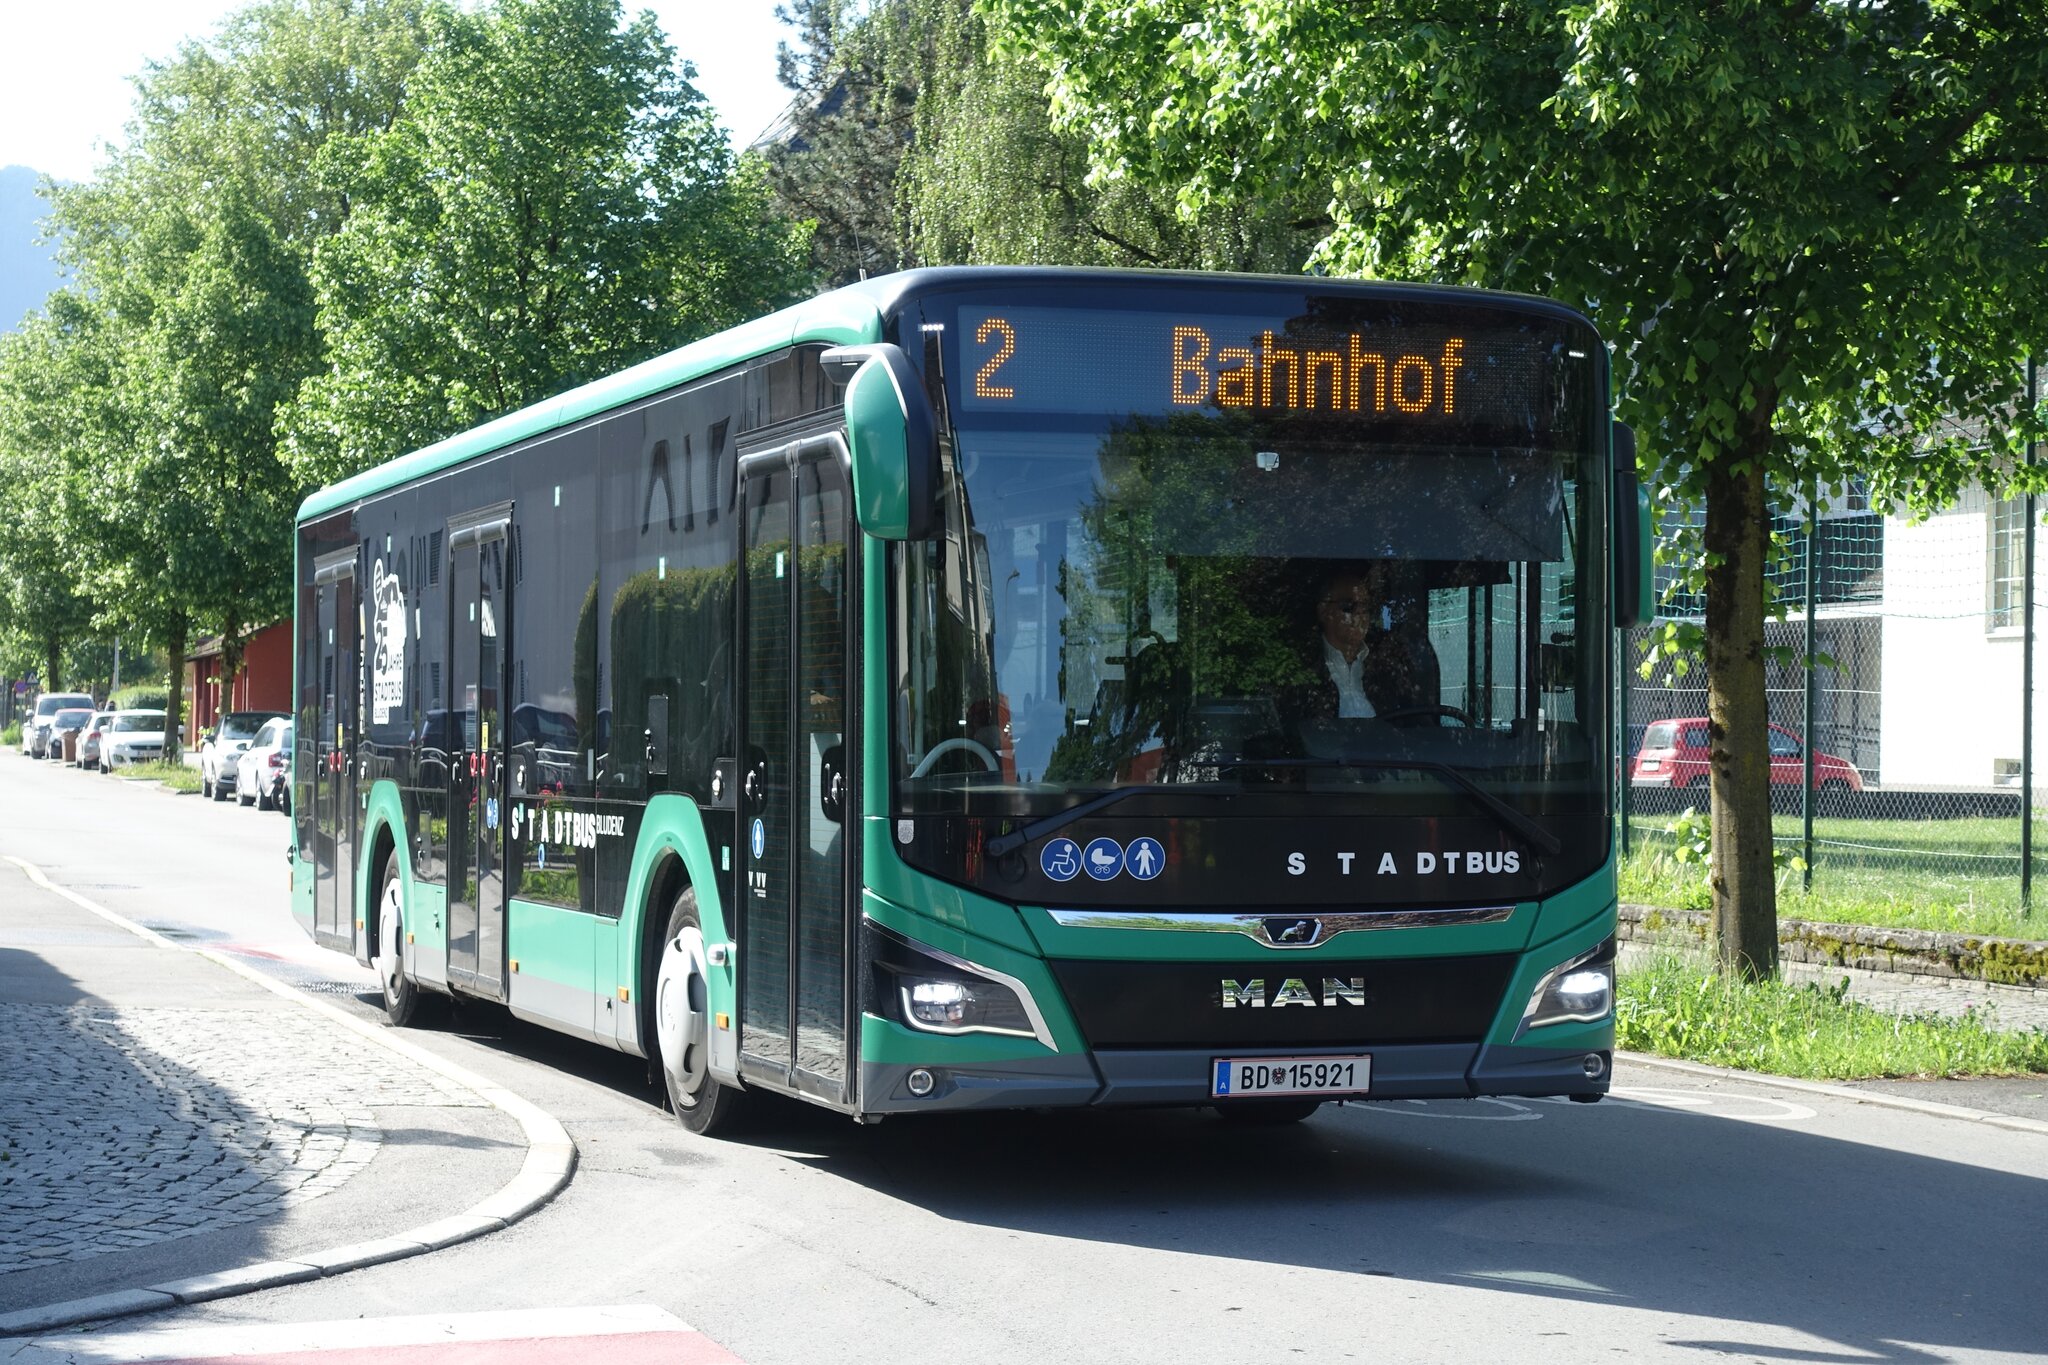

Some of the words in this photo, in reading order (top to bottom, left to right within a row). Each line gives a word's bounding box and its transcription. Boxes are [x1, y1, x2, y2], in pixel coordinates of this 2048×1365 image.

[976, 317, 1015, 398] 2
[1172, 325, 1464, 415] Bahnhof
[375, 681, 402, 701] STADTBUS
[596, 814, 625, 836] BLUDENZ
[1221, 977, 1366, 1009] MAN
[1240, 1065, 1270, 1090] BD
[1288, 1062, 1355, 1089] 15921
